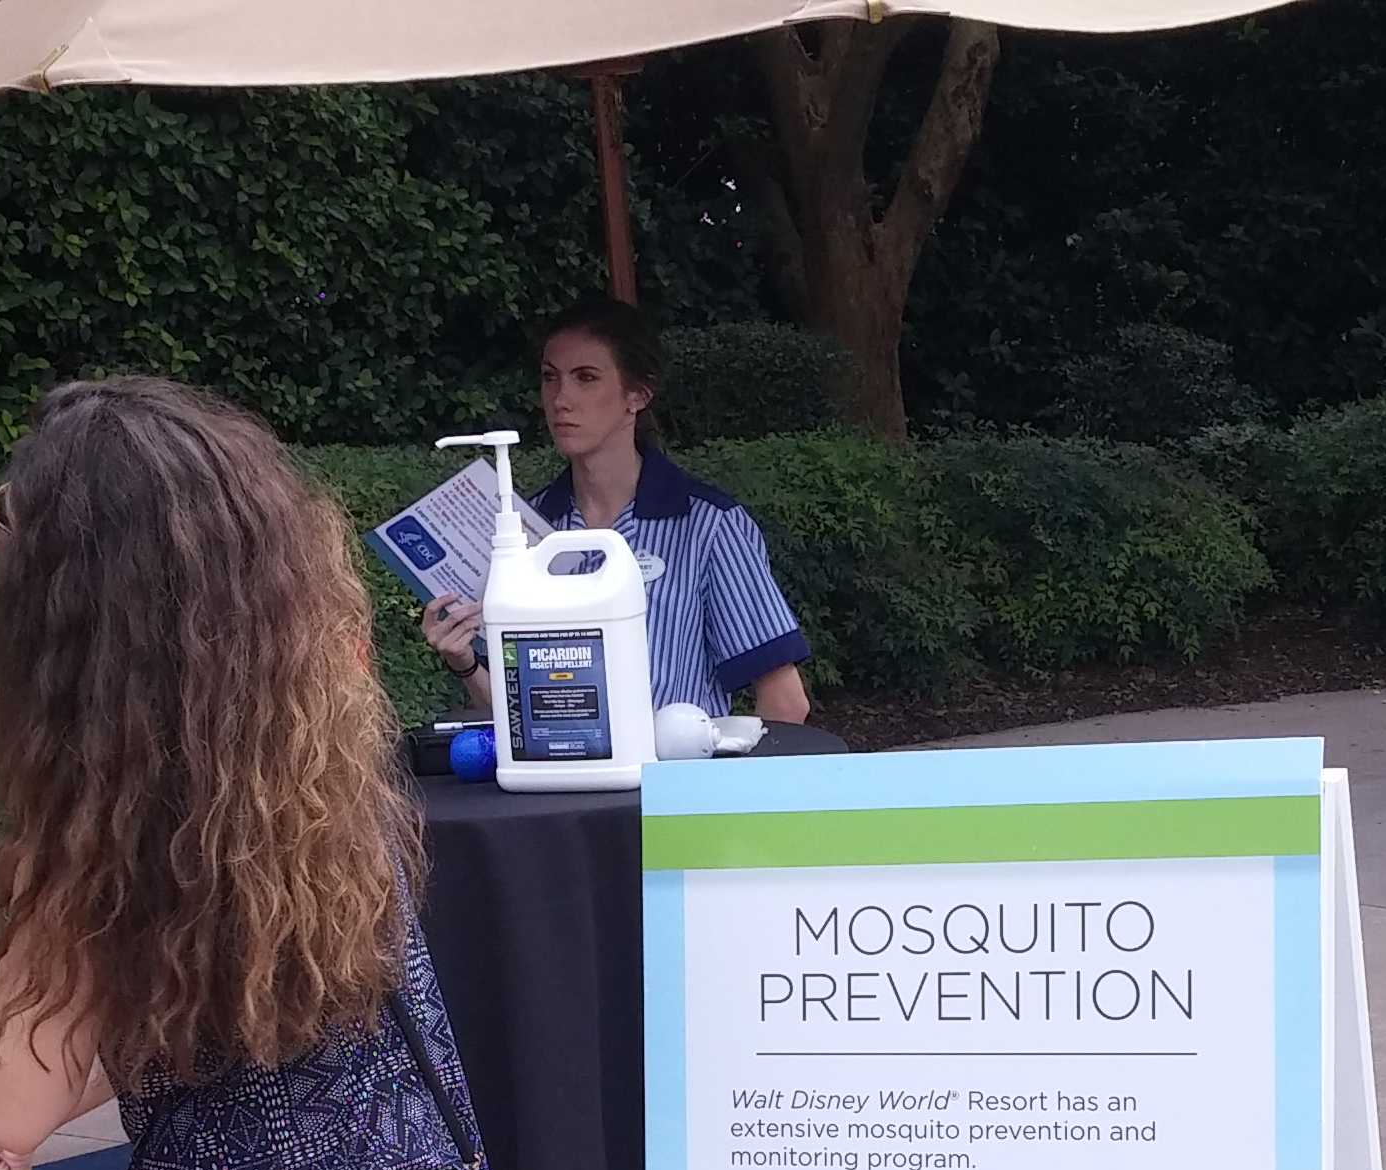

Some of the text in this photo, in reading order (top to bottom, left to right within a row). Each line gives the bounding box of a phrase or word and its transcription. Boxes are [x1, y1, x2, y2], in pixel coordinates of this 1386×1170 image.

[416, 542, 435, 562] CDC
[528, 646, 592, 662] PICARIDIN
[529, 659, 593, 670] INSECT REPELLENT
[506, 668, 524, 750] SAWYER
[795, 900, 1155, 956] MOSQUITO
[760, 969, 1193, 1022] PREVENTION
[732, 1088, 785, 1110] Walt
[790, 1089, 871, 1114] Disney
[968, 1090, 1048, 1112] Resort
[1057, 1090, 1099, 1112] has
[1107, 1095, 1137, 1112] an
[730, 1117, 1156, 1144] extensive mosquito prevention and
[731, 1146, 858, 1170] monitoring
